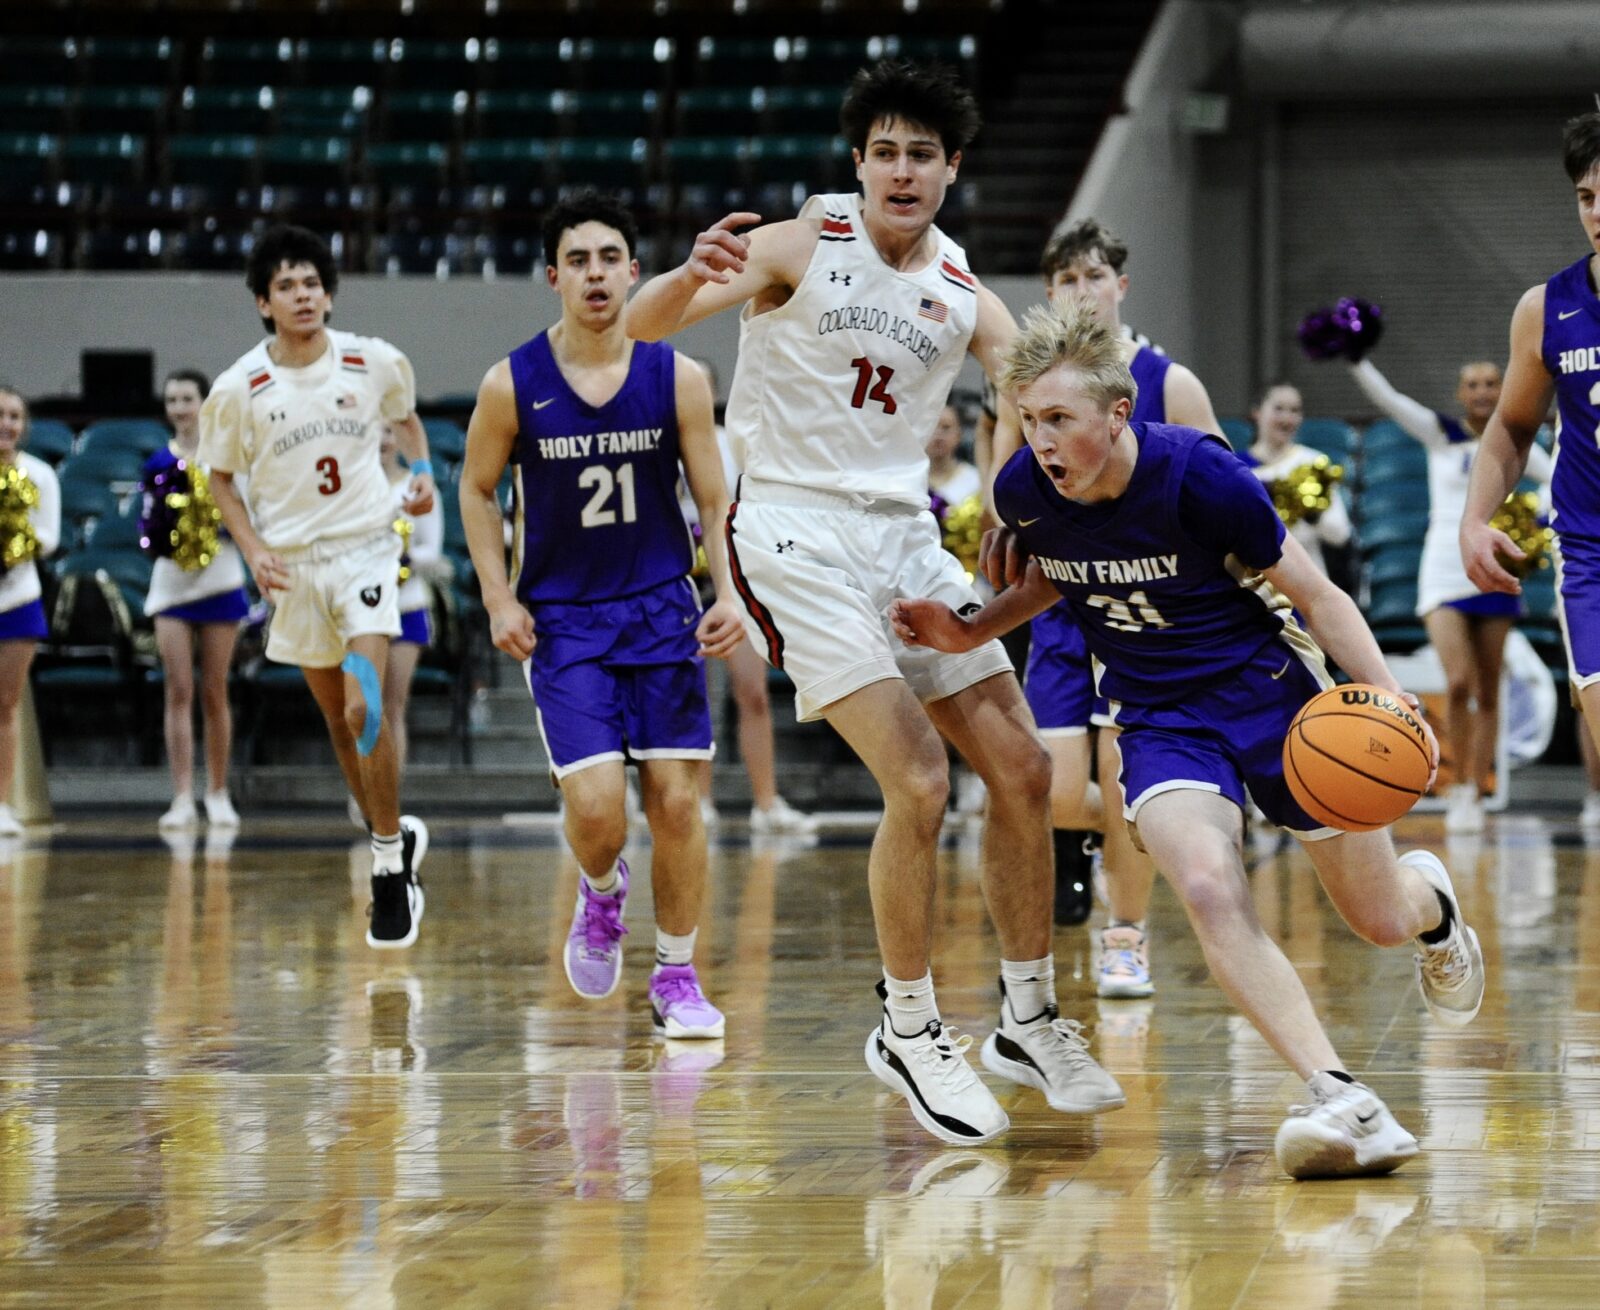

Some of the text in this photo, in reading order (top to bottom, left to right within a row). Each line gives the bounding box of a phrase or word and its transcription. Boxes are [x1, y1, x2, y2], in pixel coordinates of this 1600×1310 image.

[818, 306, 888, 335] COLORADO
[1559, 346, 1600, 374] HOL
[273, 420, 323, 456] COLORADO
[537, 427, 663, 459] HOLY FAMILY
[315, 455, 342, 496] 3
[578, 462, 637, 528] 21
[1037, 554, 1178, 584] HOLY FAMILY
[1340, 690, 1427, 747] Wilson
